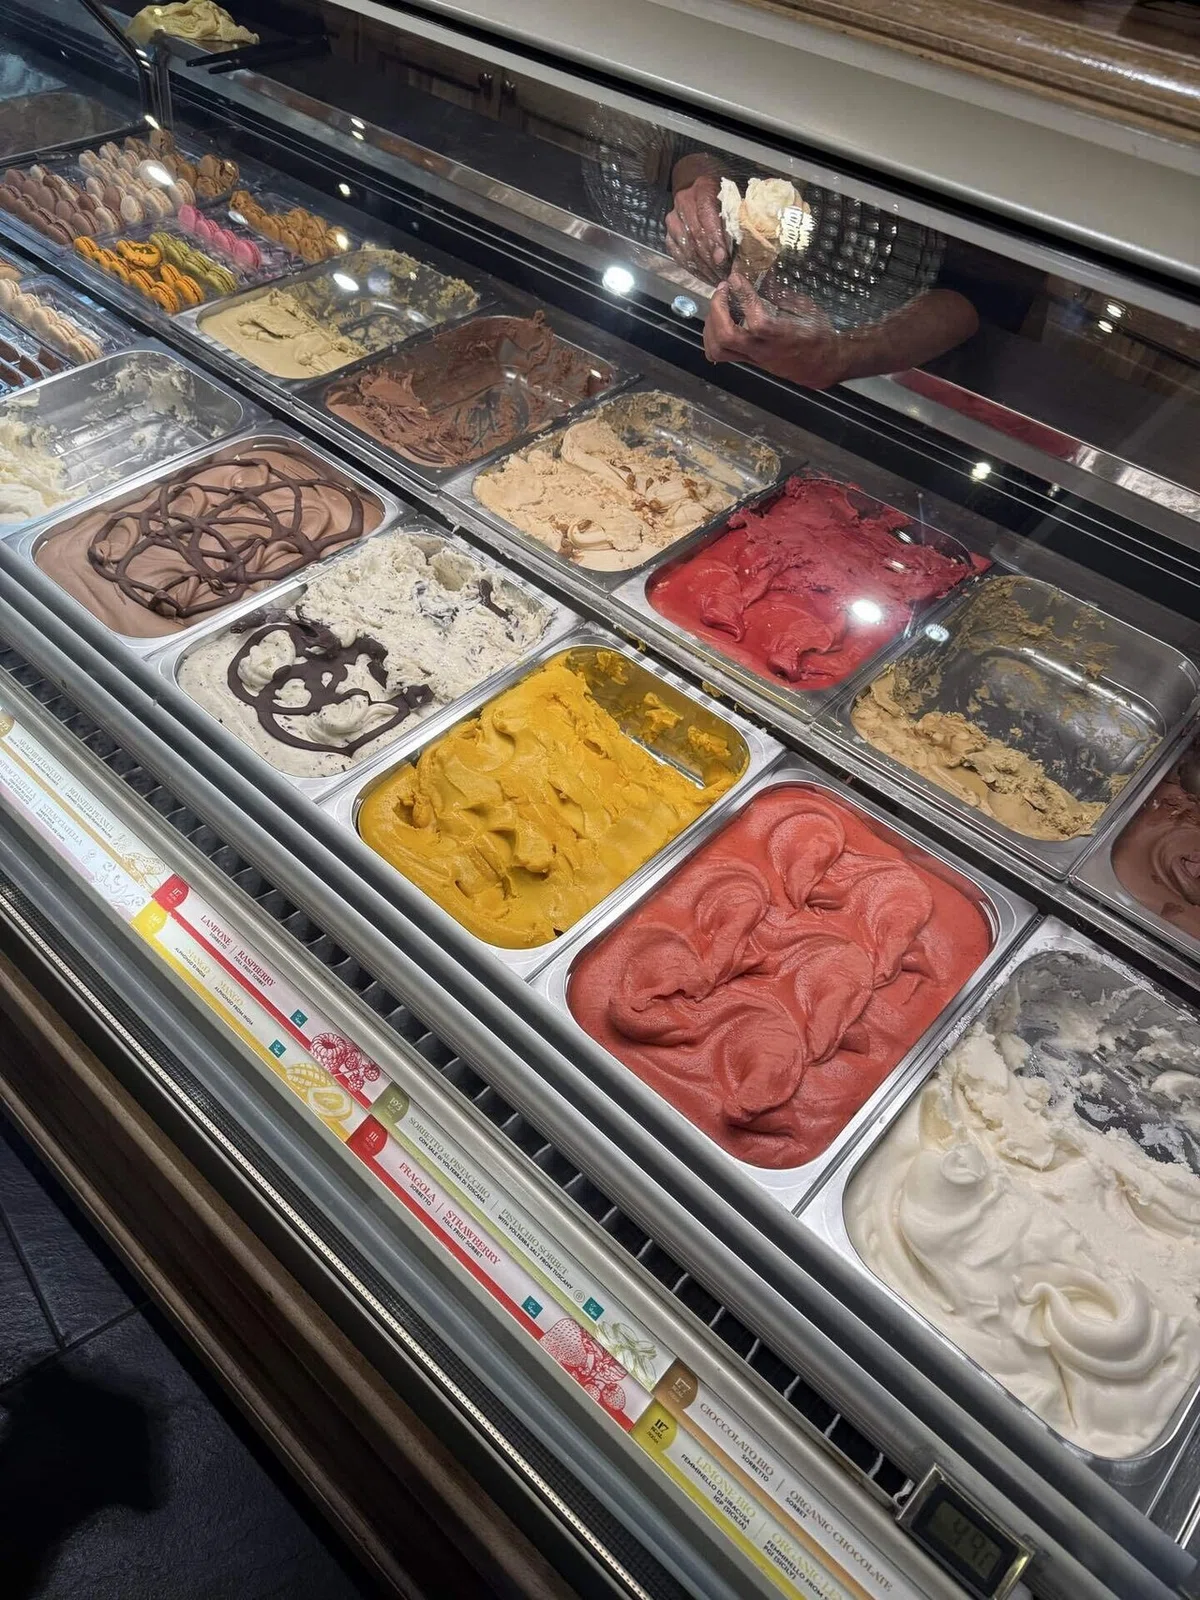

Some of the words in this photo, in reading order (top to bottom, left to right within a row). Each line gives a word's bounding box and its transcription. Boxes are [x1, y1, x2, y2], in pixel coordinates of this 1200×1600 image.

[199, 914, 233, 946] LAMPONE
[208, 932, 227, 949] SORBETTO
[173, 947, 194, 966] ALPHONSO
[185, 949, 212, 974] MANGO
[233, 956, 244, 966] FULL
[251, 973, 266, 987] SORBET
[236, 950, 276, 987] RASPBERRY
[213, 986, 234, 1006] ALPHONSO
[232, 1004, 244, 1016] FROM
[242, 1014, 254, 1025] INDIA
[217, 980, 245, 1006] MANGO
[389, 1096, 403, 1111] 193
[368, 1131, 379, 1142] 111
[408, 1116, 445, 1153] SORBETTO
[449, 1157, 491, 1199] PISTACCHIO
[418, 1136, 428, 1147] CON
[427, 1145, 438, 1156] SALE
[441, 1159, 462, 1180] VOLTERRA
[466, 1183, 486, 1203] TOSCANA
[398, 1162, 438, 1202] FRAGOLA
[409, 1183, 432, 1206] SORBETTO
[441, 1216, 454, 1229] FULL
[452, 1227, 466, 1241] FRUIT
[465, 1240, 483, 1258] SORBET
[445, 1210, 501, 1266] STRAWBERRY
[497, 1214, 509, 1227] WITH
[507, 1225, 530, 1248] VOLTERRA
[529, 1246, 540, 1258] SALT
[539, 1256, 553, 1270] FROM
[552, 1269, 573, 1290] TUSCANY
[501, 1208, 540, 1247] PISTACHIO
[537, 1244, 568, 1275] SORBET
[654, 1419, 669, 1434] 117
[698, 1402, 759, 1460] CIOCCOLATO
[756, 1457, 776, 1476] BIO
[694, 1455, 740, 1499] LIMONE
[734, 1496, 758, 1518] BIO
[740, 1454, 770, 1482] SORBETTO
[679, 1453, 718, 1490] FEMMINELLO
[716, 1489, 725, 1498] DI
[722, 1496, 752, 1525] SIRACUSA
[712, 1495, 724, 1506] IGP
[721, 1505, 748, 1530] (SICILIA)
[784, 1497, 807, 1519] SORBET
[769, 1531, 823, 1582] ORGANIC
[787, 1489, 835, 1534] ORGANIC
[829, 1530, 895, 1593] CHOCOLATE
[762, 1545, 775, 1557] PGI
[772, 1555, 798, 1580] (SICILY)
[765, 1539, 807, 1580] FEMMINELLO
[803, 1577, 824, 1597] FROM
